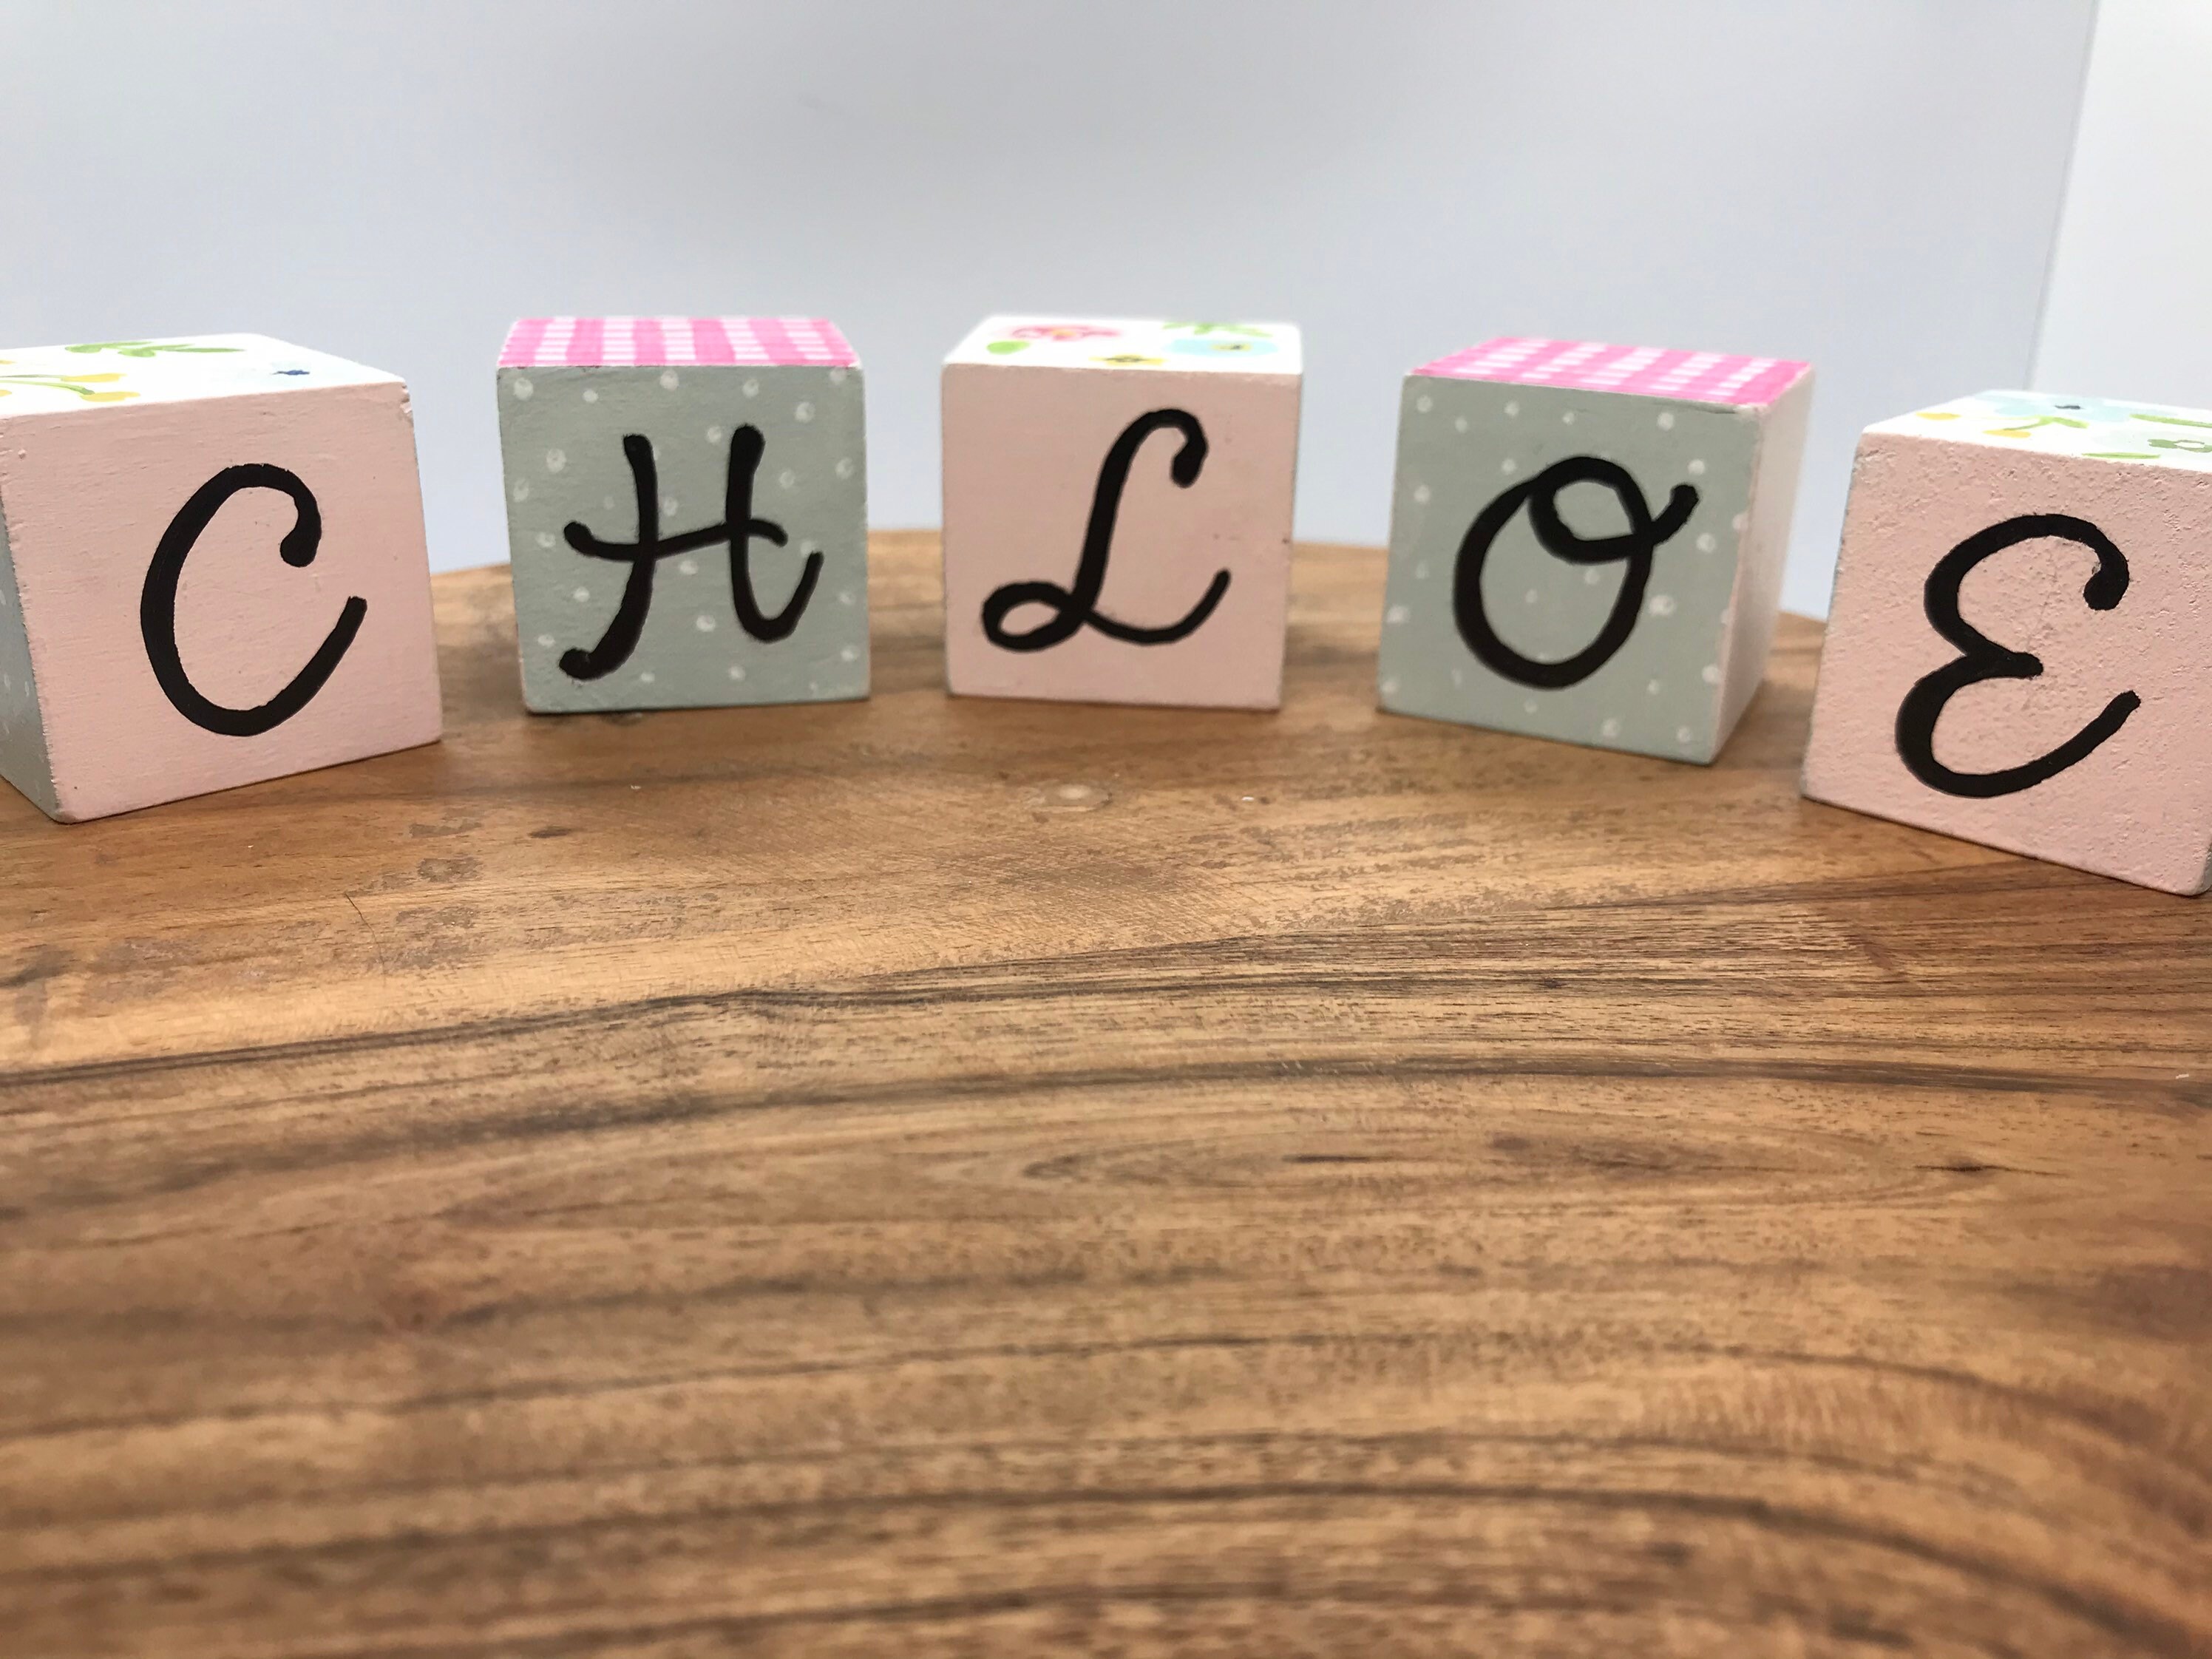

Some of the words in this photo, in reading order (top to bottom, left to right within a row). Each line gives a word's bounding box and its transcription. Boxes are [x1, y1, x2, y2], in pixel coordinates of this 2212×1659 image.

[139, 462, 368, 738] C
[557, 422, 824, 682] H
[980, 407, 1231, 653] L
[1451, 455, 1700, 691] O
[1894, 512, 2143, 799] E
